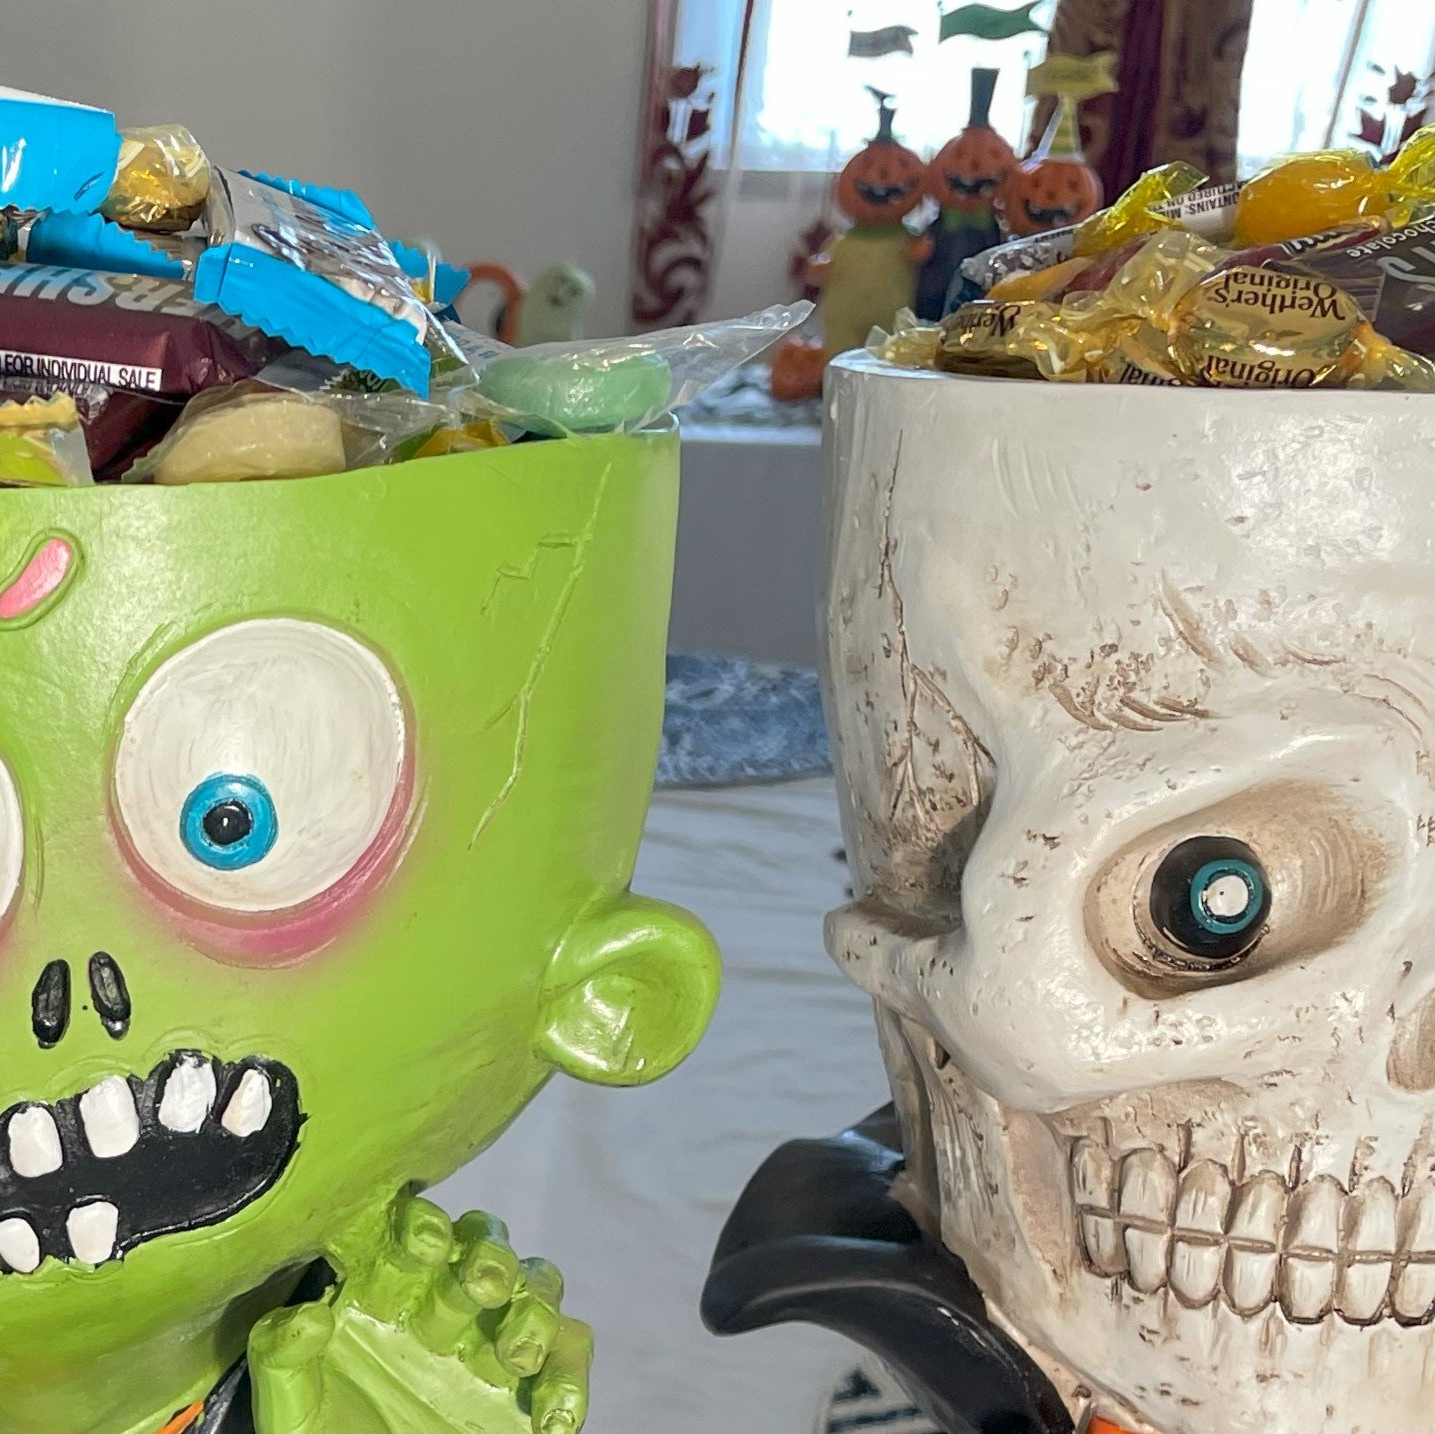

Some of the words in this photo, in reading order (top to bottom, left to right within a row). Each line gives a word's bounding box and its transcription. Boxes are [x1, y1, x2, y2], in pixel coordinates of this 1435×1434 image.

[1346, 220, 1435, 258] chocolate
[1213, 286, 1346, 321] Werther's
[1223, 271, 1337, 301] Original
[4, 354, 33, 376] FOR
[36, 356, 113, 385] INDIVIDUAL
[117, 367, 156, 391] SALE
